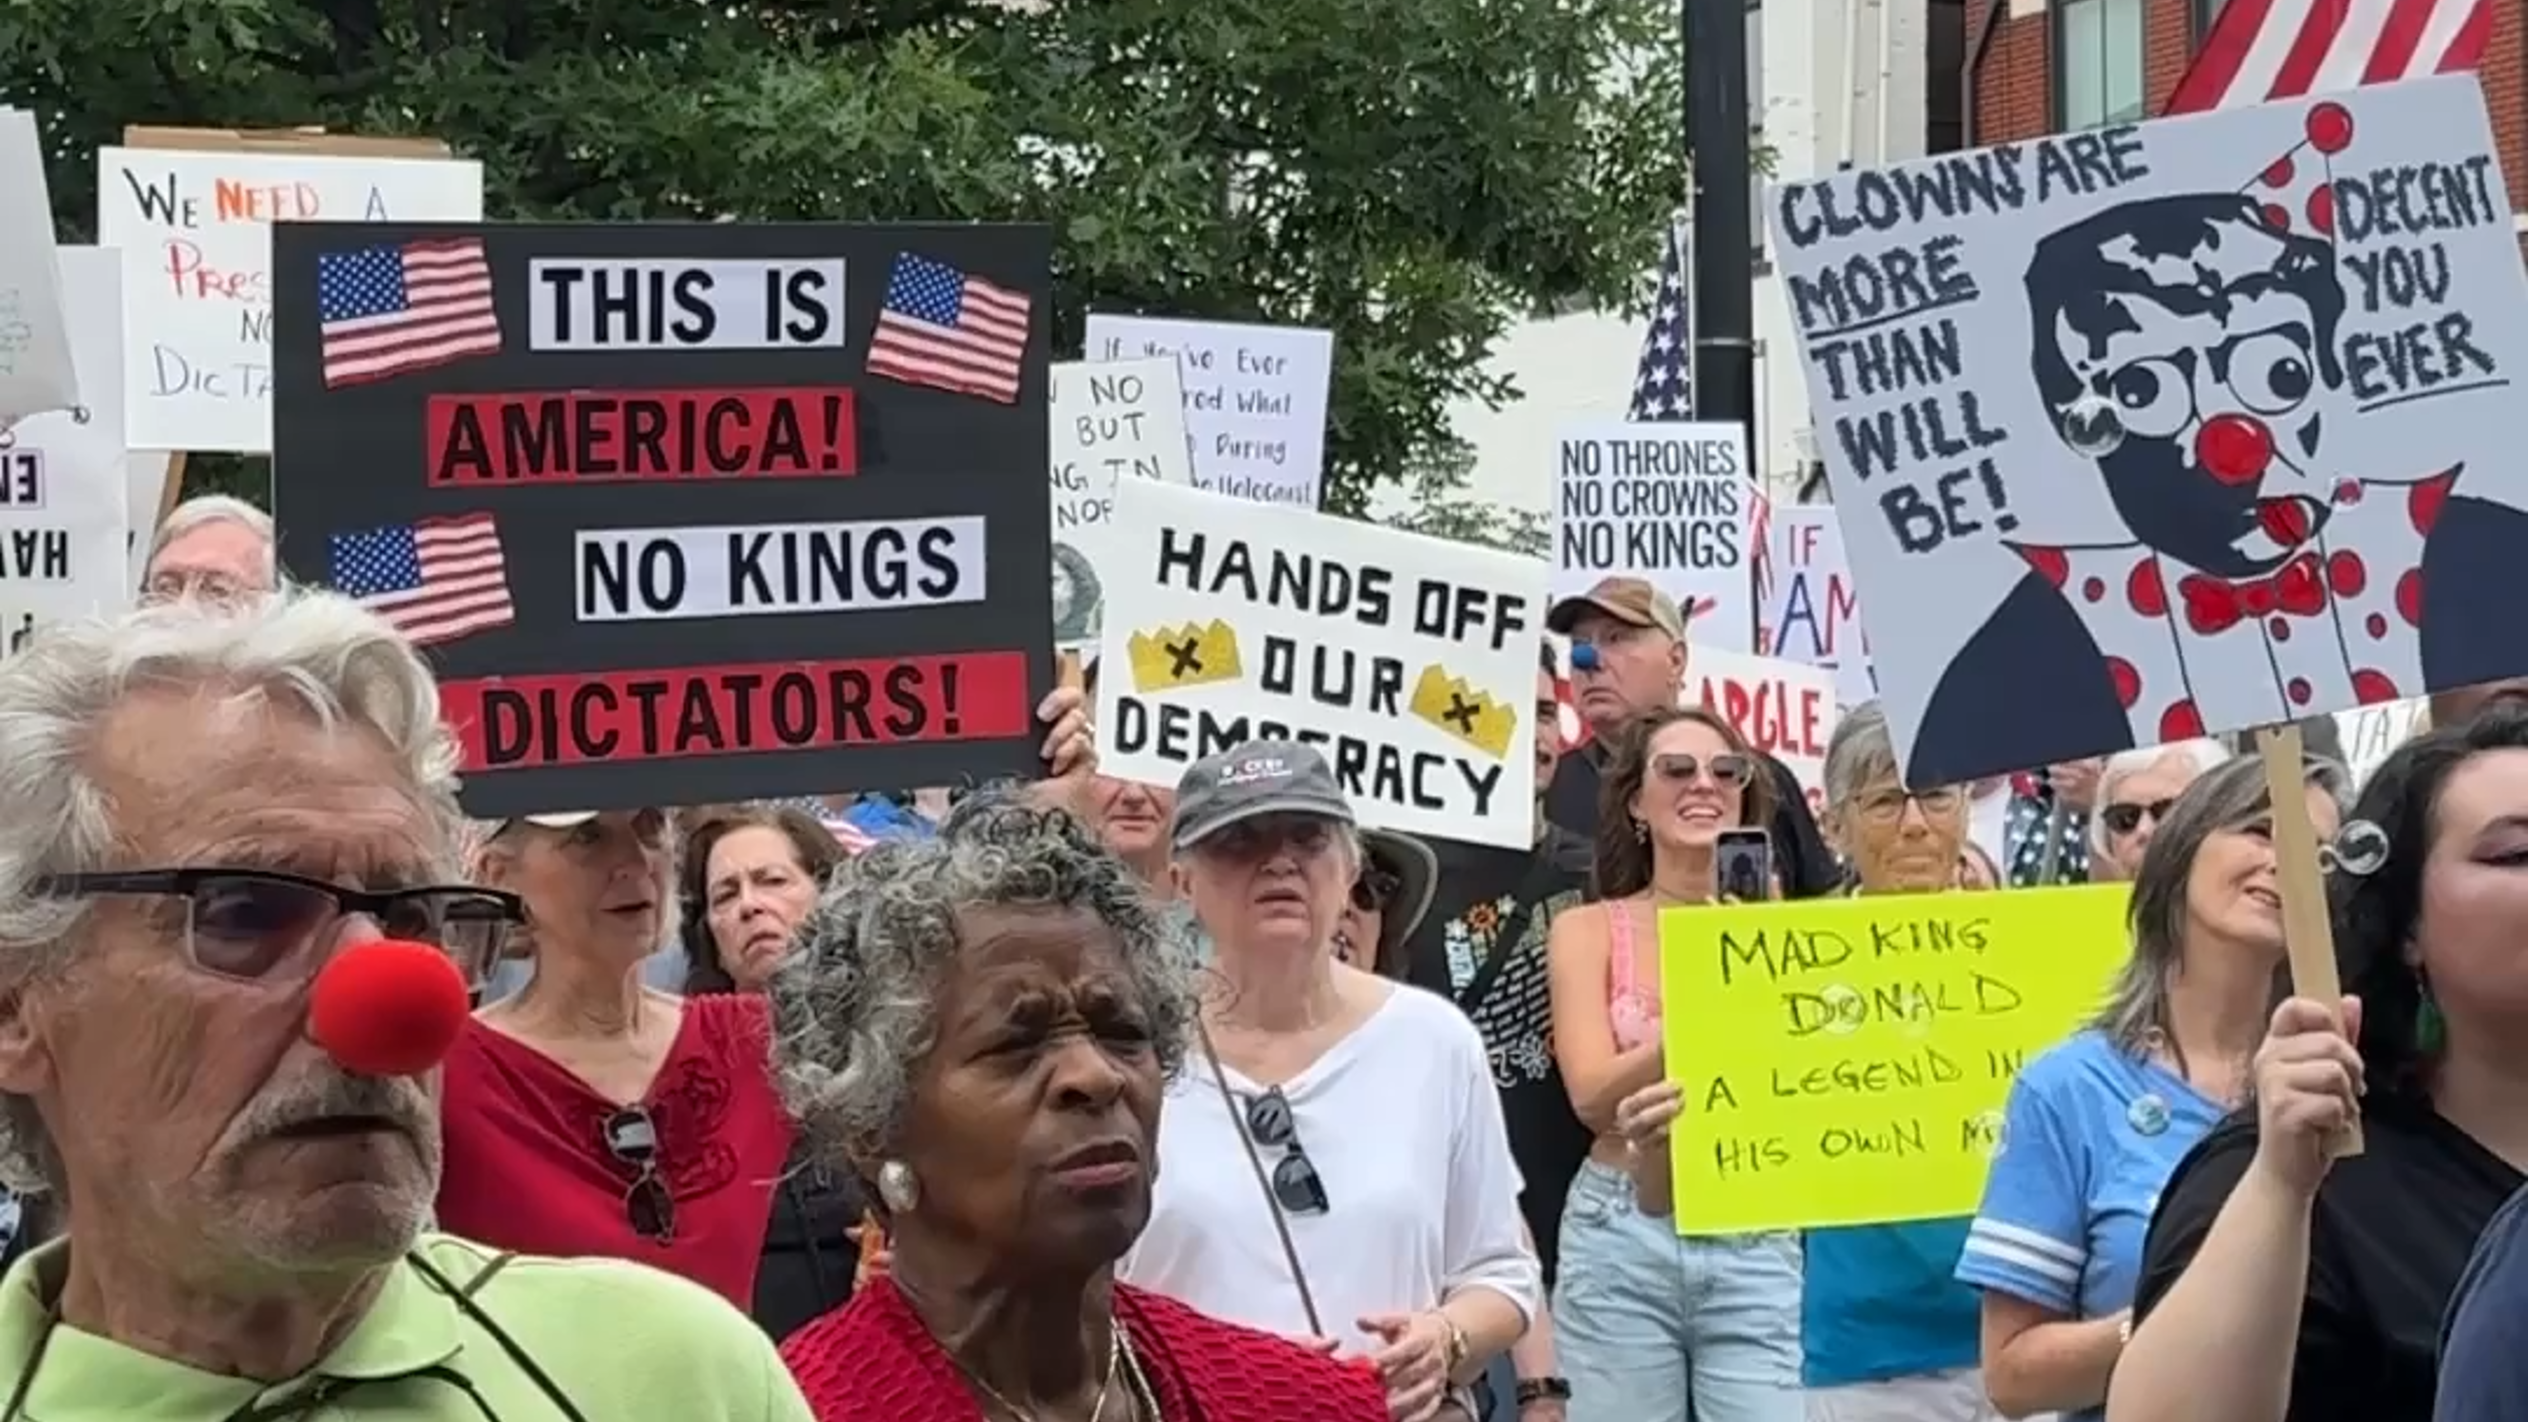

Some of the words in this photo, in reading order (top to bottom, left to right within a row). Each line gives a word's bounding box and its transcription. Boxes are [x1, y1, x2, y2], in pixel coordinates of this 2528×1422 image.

[215, 177, 319, 223] NEED
[365, 187, 388, 221] A
[1779, 145, 2025, 249] CLOWNS
[2037, 126, 2149, 203] ARE
[2332, 155, 2497, 245] DECENT
[541, 267, 716, 344] THIS
[766, 268, 829, 344] IS
[1789, 235, 1977, 330] MORE
[2342, 242, 2451, 312] YOU
[1090, 375, 1143, 406] NO
[1809, 318, 1961, 401] THAN
[2342, 311, 2497, 400] EVER
[436, 395, 842, 481] AMERICA!
[1076, 412, 1146, 447] BUT
[1216, 432, 1286, 465] During
[1562, 440, 1601, 476] NO
[1606, 440, 1736, 476] THRONES
[1835, 390, 2007, 480] WILL
[1051, 461, 1089, 492] NG
[1562, 480, 1603, 517] NO
[1611, 479, 1738, 517] CROWNS
[1879, 458, 2019, 554] BE!
[582, 537, 686, 616] NO
[728, 527, 960, 606] KINGS
[1562, 522, 1614, 570] NO
[1626, 521, 1739, 570] KINGS
[1789, 524, 1823, 567] IF
[1157, 527, 1392, 627] HANDS
[1414, 579, 1527, 650] OFF
[1261, 635, 1404, 717] OUR
[482, 664, 961, 765] DICTATORS!
[1115, 696, 1502, 817] DEMRACY
[1719, 928, 1853, 985] MAD
[1870, 917, 1992, 958] KING
[1781, 971, 2022, 1036] DONALD
[1705, 1076, 1738, 1112] A
[1771, 1045, 1963, 1098] LEGEND
[1714, 1136, 1791, 1181] HIS
[1820, 1119, 1927, 1159] OWN
